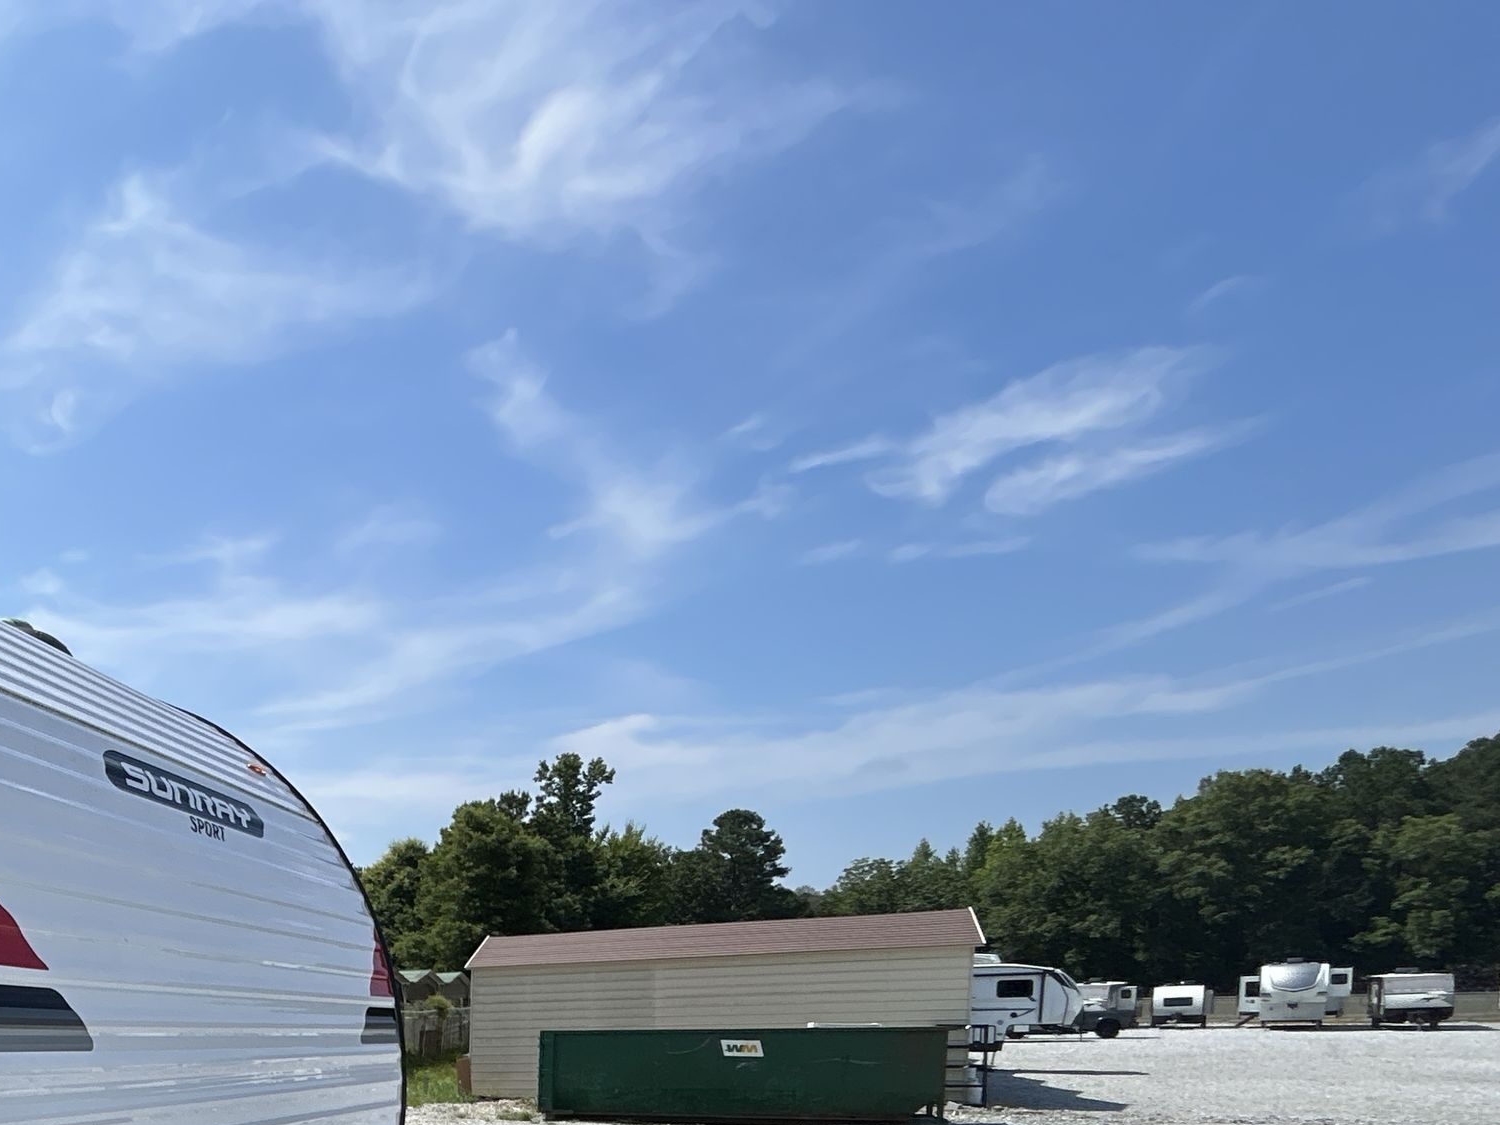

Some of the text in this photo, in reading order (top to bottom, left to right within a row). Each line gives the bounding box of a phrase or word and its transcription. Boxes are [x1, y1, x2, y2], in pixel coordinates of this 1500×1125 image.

[120, 761, 252, 829] SUNRAY
[189, 815, 226, 842] SPORT
[725, 1044, 758, 1053] WM
